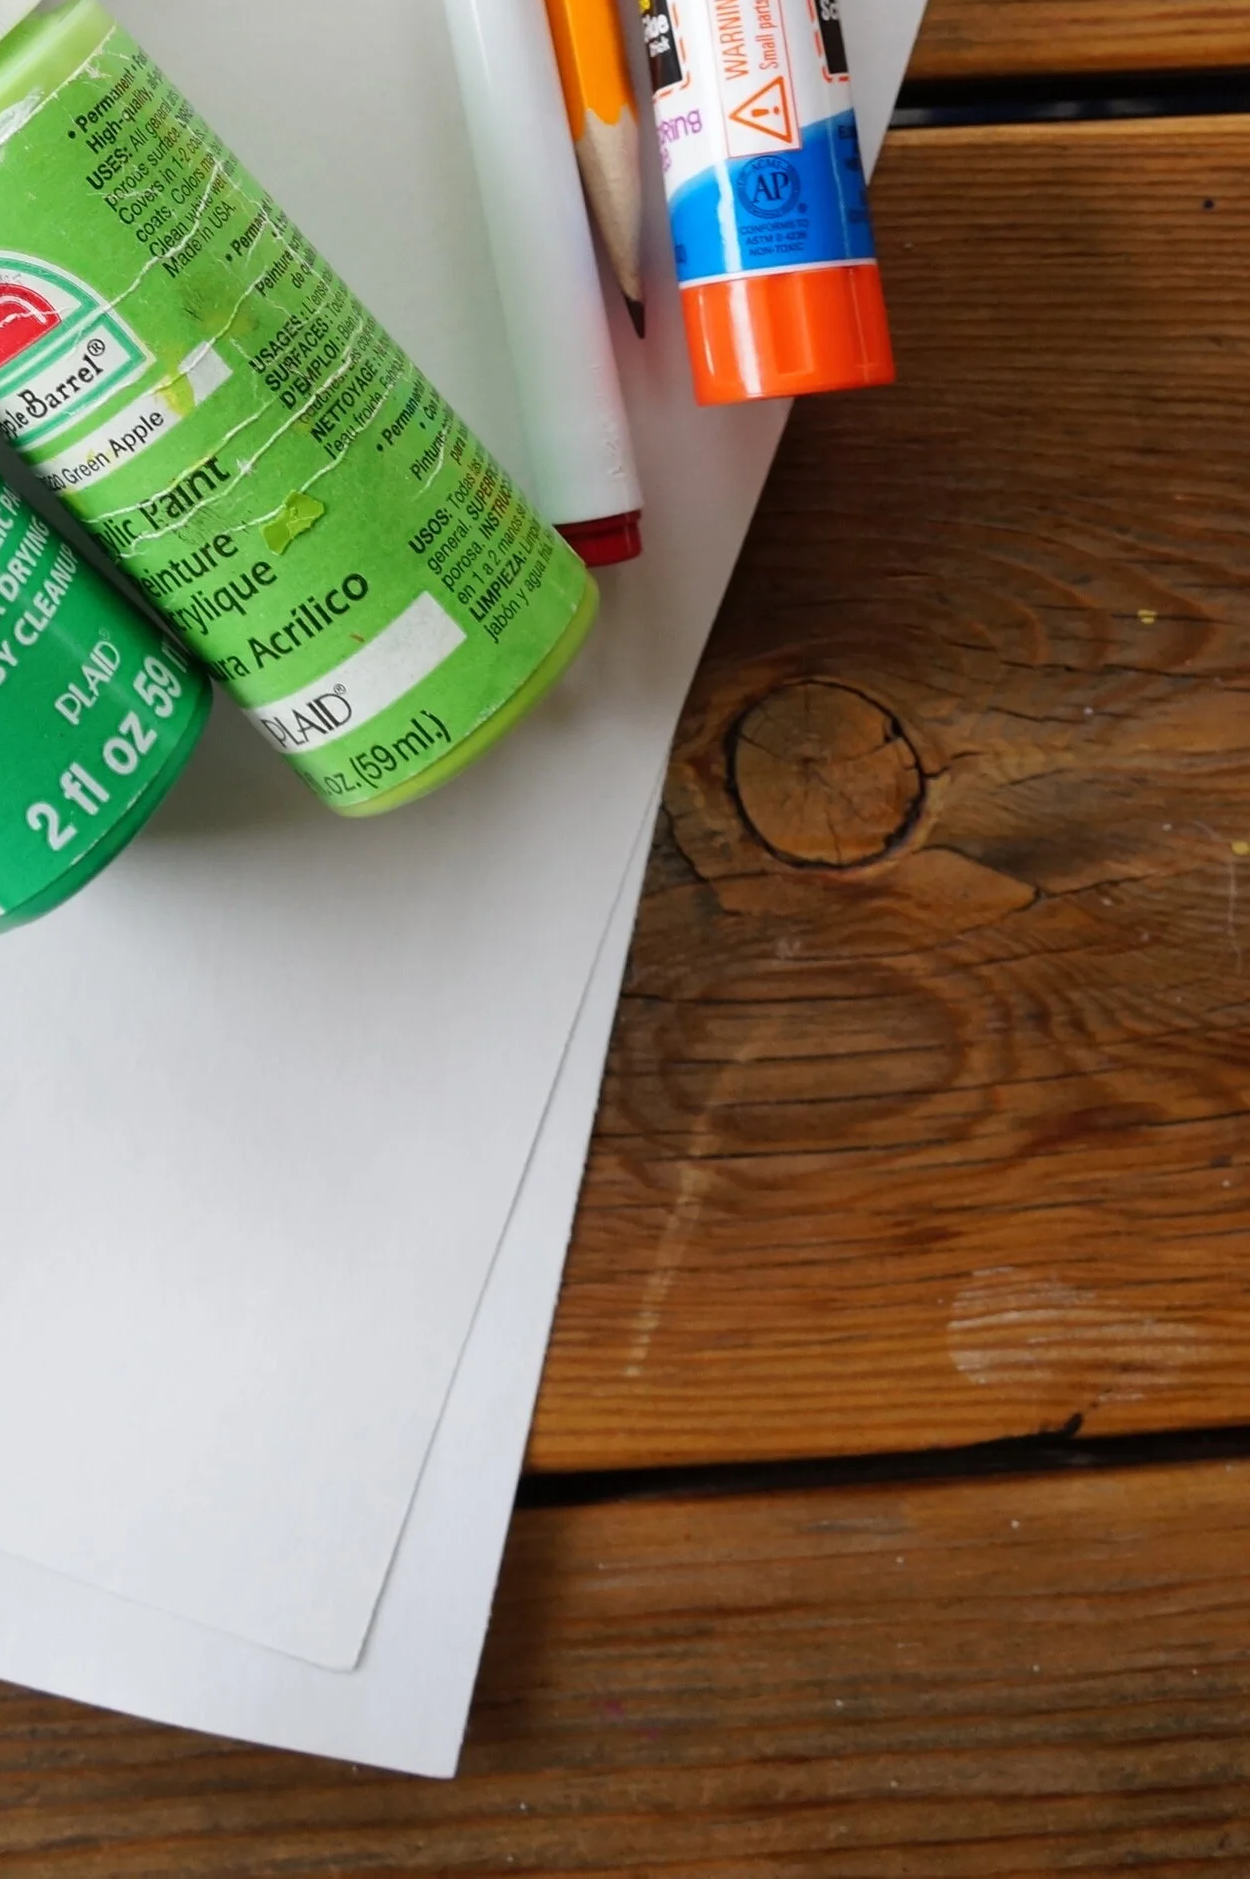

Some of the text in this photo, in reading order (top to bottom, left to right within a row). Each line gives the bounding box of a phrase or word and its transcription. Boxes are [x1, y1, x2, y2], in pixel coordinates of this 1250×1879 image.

[759, 35, 778, 71] Small
[76, 69, 135, 133] Permanent
[86, 147, 133, 191] USES:
[130, 128, 149, 152] All
[104, 160, 149, 212] porous
[171, 167, 206, 205] Colors
[753, 171, 789, 203] AP
[118, 179, 165, 225] Covers
[163, 168, 177, 185] in
[162, 241, 202, 278] Made
[210, 201, 236, 230] USA.
[310, 363, 379, 443] NETTOYAGE
[62, 452, 111, 485] Green
[109, 410, 164, 458] Apple
[139, 456, 231, 530] Paint
[408, 508, 454, 554] USOS:
[13, 542, 79, 646] CLEANUP
[139, 532, 239, 601] einture
[441, 543, 486, 593] porosa.
[457, 584, 476, 605] en
[469, 550, 528, 623] LIMPIEZA:
[523, 560, 549, 595] agua
[247, 572, 369, 669] Acrílico
[55, 640, 121, 725] PLAID
[26, 801, 78, 851] 2
[60, 761, 110, 815] fl
[103, 710, 158, 775] oz
[133, 656, 182, 718] 59
